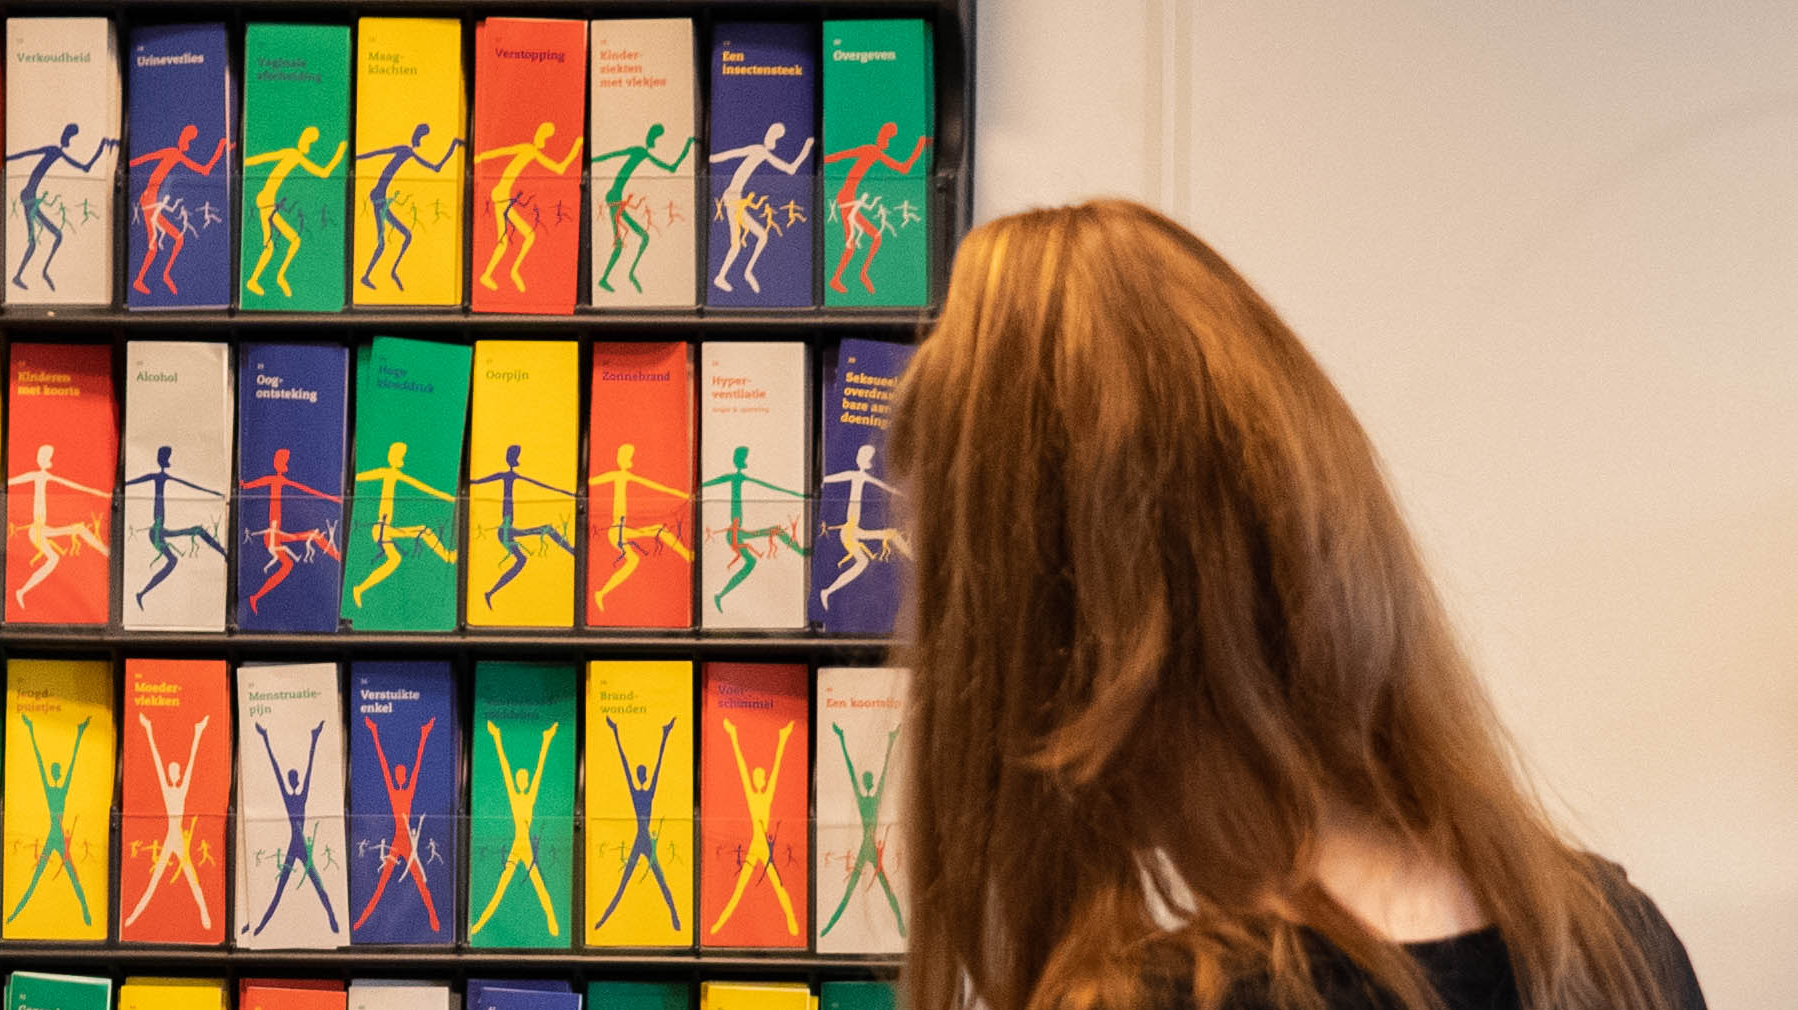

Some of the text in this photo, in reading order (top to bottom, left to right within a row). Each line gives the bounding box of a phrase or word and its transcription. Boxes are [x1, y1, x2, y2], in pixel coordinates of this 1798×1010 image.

[16, 52, 91, 64] Verkoudheid
[137, 53, 204, 68] Urineverlies
[368, 51, 404, 64] Maag-
[495, 47, 566, 63] Verstopping
[599, 50, 642, 61] Kinder-
[722, 50, 745, 62] Een
[833, 49, 896, 64] Overgeven
[367, 64, 418, 76] klachten
[722, 63, 803, 76] insectensteek
[599, 76, 667, 89] met vlekjes
[17, 371, 71, 383] Kinderen
[136, 371, 178, 383] Alcohol
[256, 374, 284, 388] Oog-
[486, 370, 529, 382] Oorpijn
[602, 371, 670, 382] Zonnebrand
[711, 376, 752, 388] Hyper-
[17, 384, 80, 397] met koorts
[255, 387, 318, 403] ontsteking
[711, 388, 767, 399] ventilatie
[134, 682, 182, 694] Moeder-
[360, 688, 420, 700] Verstuikte
[134, 696, 180, 707] vlekken
[249, 689, 321, 702] Menstruatie-
[360, 702, 392, 713] enkel
[826, 697, 847, 708] Een
[249, 704, 272, 717] pijn
[601, 704, 647, 714] wonden
